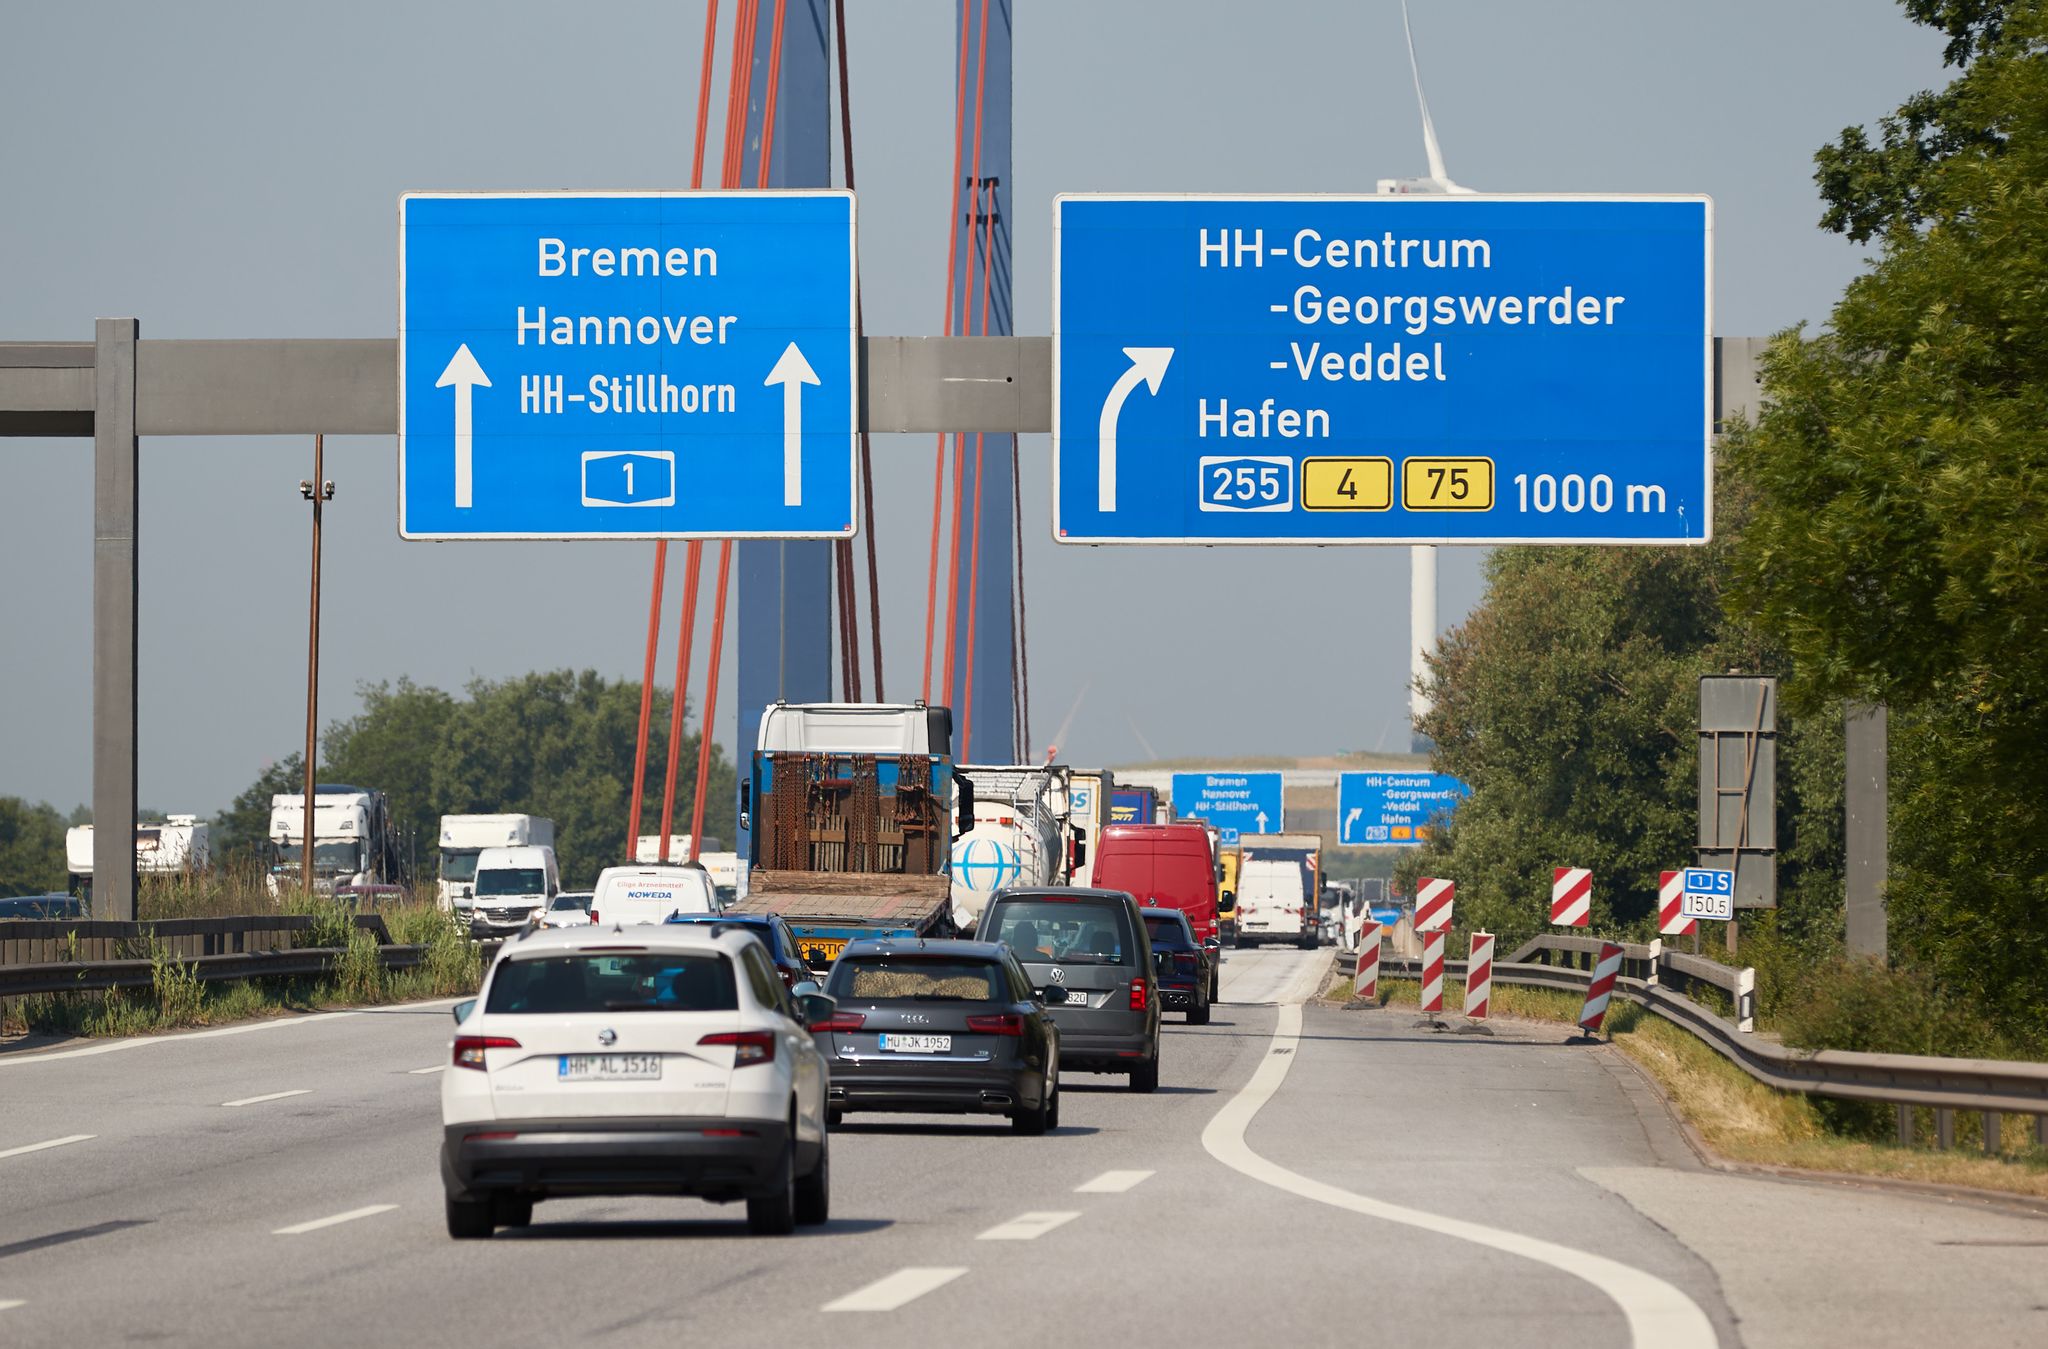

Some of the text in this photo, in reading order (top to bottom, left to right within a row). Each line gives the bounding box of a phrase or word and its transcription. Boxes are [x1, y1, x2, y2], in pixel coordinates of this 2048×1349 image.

[538, 237, 718, 277] Bremen
[1199, 228, 1492, 268] HH-Centrum
[1269, 285, 1626, 335] -Georgswerder
[517, 306, 738, 346] Hannover
[1269, 342, 1447, 382] -Veddel
[520, 374, 736, 414] HH-Stillhorn
[1198, 398, 1330, 438] Hafen
[622, 462, 634, 495] 1
[1212, 467, 1667, 513] 255 4 75 1000 m
[1202, 789, 1251, 799] Hannover
[1206, 775, 1248, 787] Bremen
[1366, 776, 1431, 788] HH-Centrum
[1381, 813, 1411, 825] Hafen
[627, 891, 672, 899] NOWEDA
[1716, 873, 1729, 891] S
[1688, 895, 1726, 914] 150.5
[907, 1037, 921, 1048] JK
[923, 1037, 950, 1049] 1952
[600, 1056, 618, 1074] AL
[621, 1056, 658, 1074] 1516
